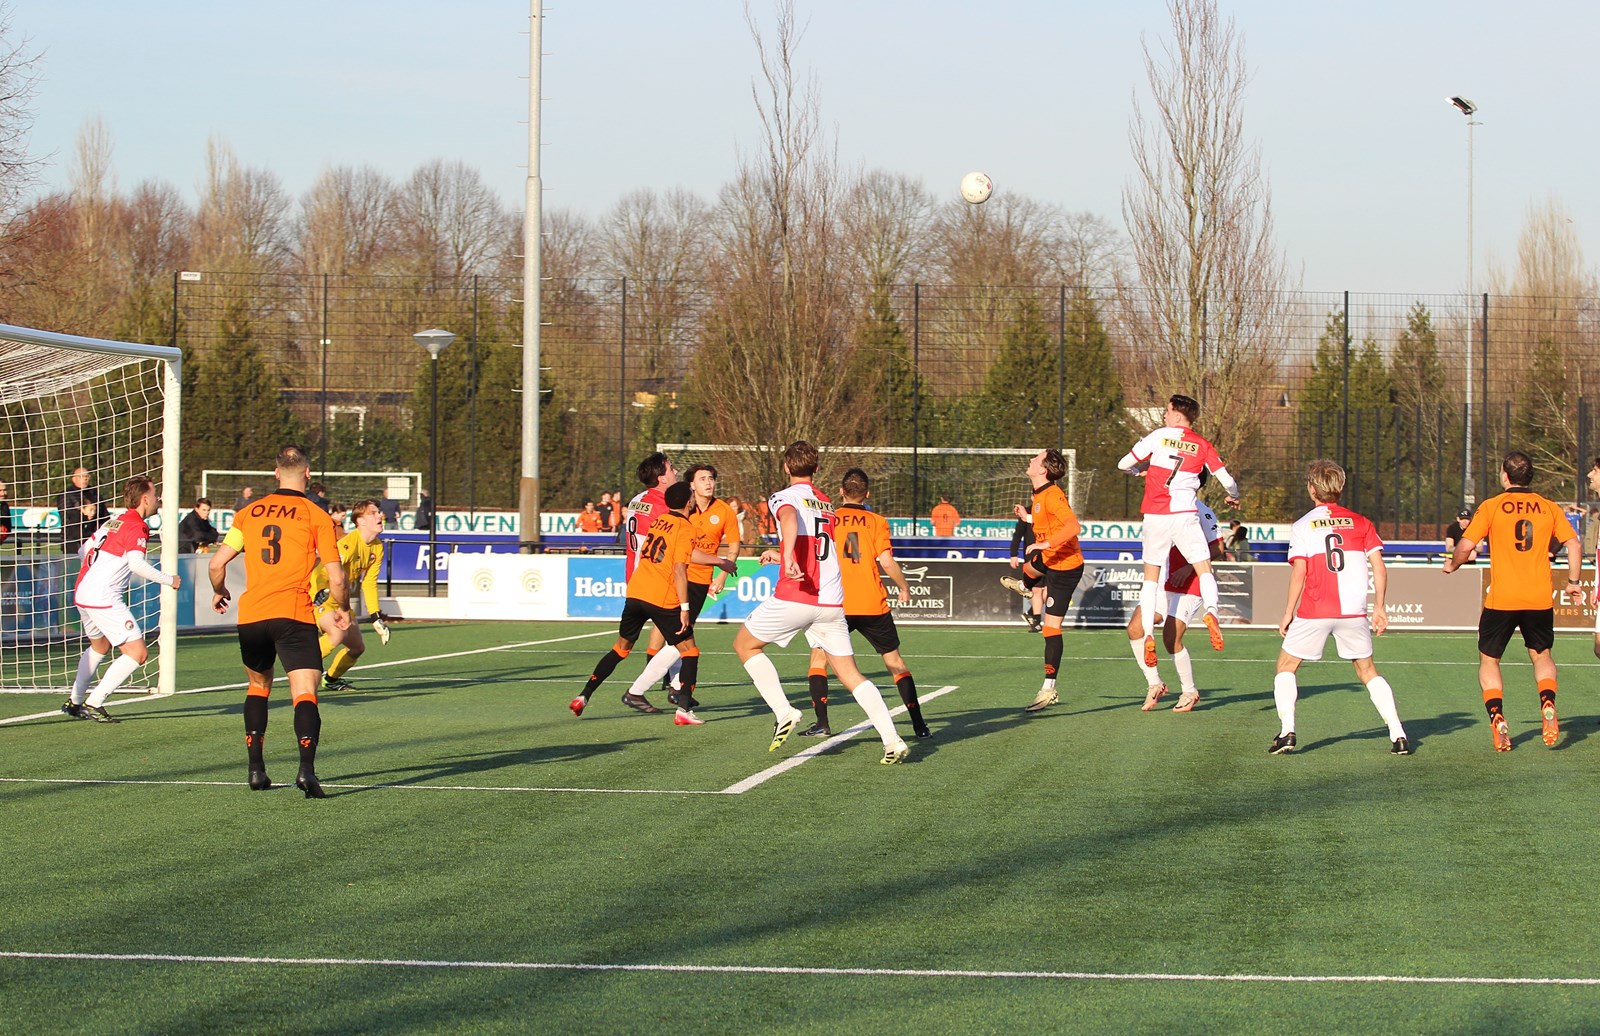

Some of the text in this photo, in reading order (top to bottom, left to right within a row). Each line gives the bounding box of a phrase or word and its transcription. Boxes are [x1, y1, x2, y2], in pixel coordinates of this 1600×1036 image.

[1164, 438, 1196, 452] THUYS
[1165, 454, 1184, 488] 7
[629, 516, 638, 551] 8
[814, 517, 830, 562] 5
[1312, 518, 1351, 528] THUYS
[1515, 519, 1533, 552] 9
[261, 524, 282, 565] 3
[641, 532, 668, 564] 20
[843, 531, 861, 564] 4
[1325, 533, 1345, 573] 6
[909, 586, 931, 596] SON
